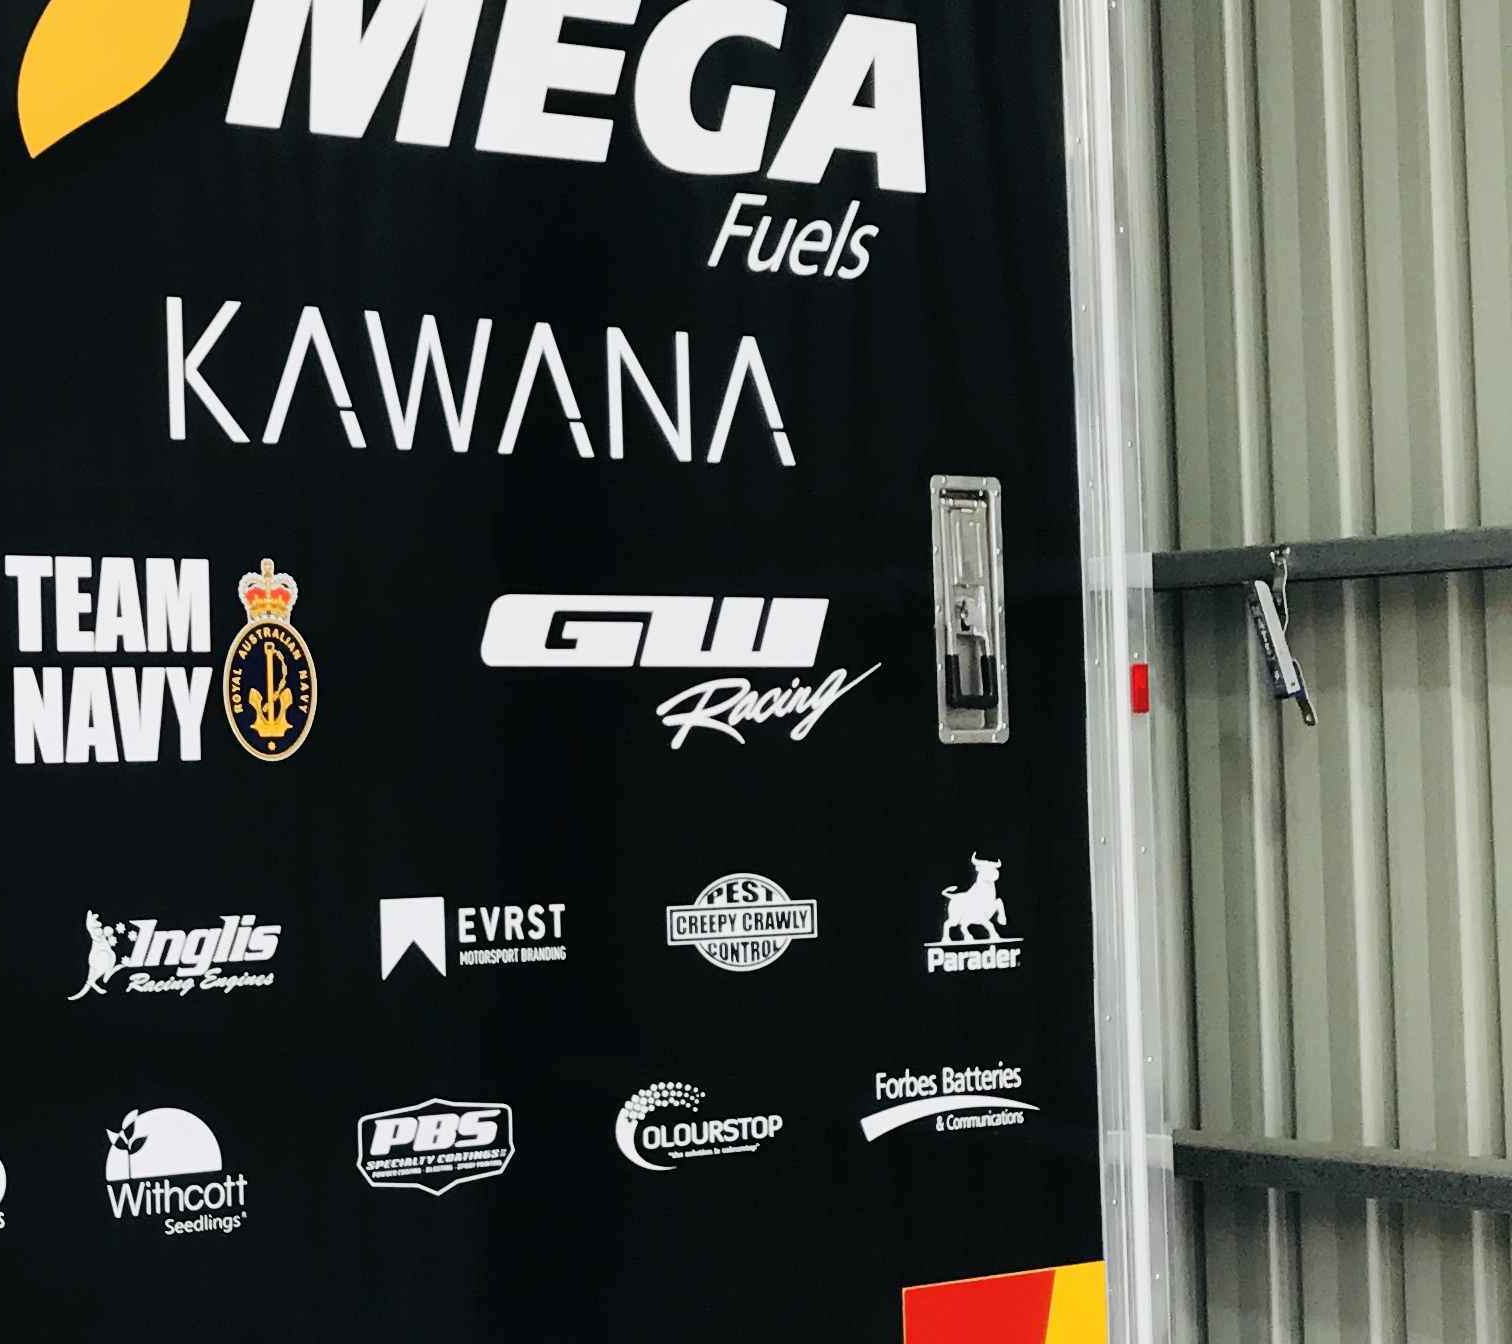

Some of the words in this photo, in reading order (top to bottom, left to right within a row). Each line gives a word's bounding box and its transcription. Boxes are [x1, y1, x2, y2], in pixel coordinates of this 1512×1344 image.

[709, 193, 880, 279] Fuels
[166, 297, 796, 466] KAWANA
[5, 555, 211, 652] TEAM
[481, 594, 829, 667] GW
[231, 667, 244, 714] ROYAL
[238, 626, 302, 661] AUSTRALIAN
[298, 669, 310, 714] NAVY
[14, 667, 213, 764] NAVY
[656, 663, 881, 749] Racing
[706, 881, 778, 905] PEST
[459, 904, 565, 943] EVRST
[676, 913, 737, 936] CREEPY
[742, 910, 808, 932] CRAWLY
[128, 913, 283, 978] Inglis
[460, 948, 519, 965] MOTORSPORT
[521, 946, 566, 962] BRANDING
[707, 939, 781, 964] CONTROL
[926, 945, 1022, 974] Parader
[125, 972, 196, 997] Racing
[199, 967, 275, 994] Engines
[876, 1069, 940, 1102] Forbes
[942, 1061, 1021, 1094] Batteries
[369, 1108, 502, 1157] PBS
[934, 1113, 944, 1131] &
[946, 1108, 1024, 1130] Communications
[365, 1156, 437, 1172] SPECIALTY
[105, 1173, 249, 1219] Withcott
